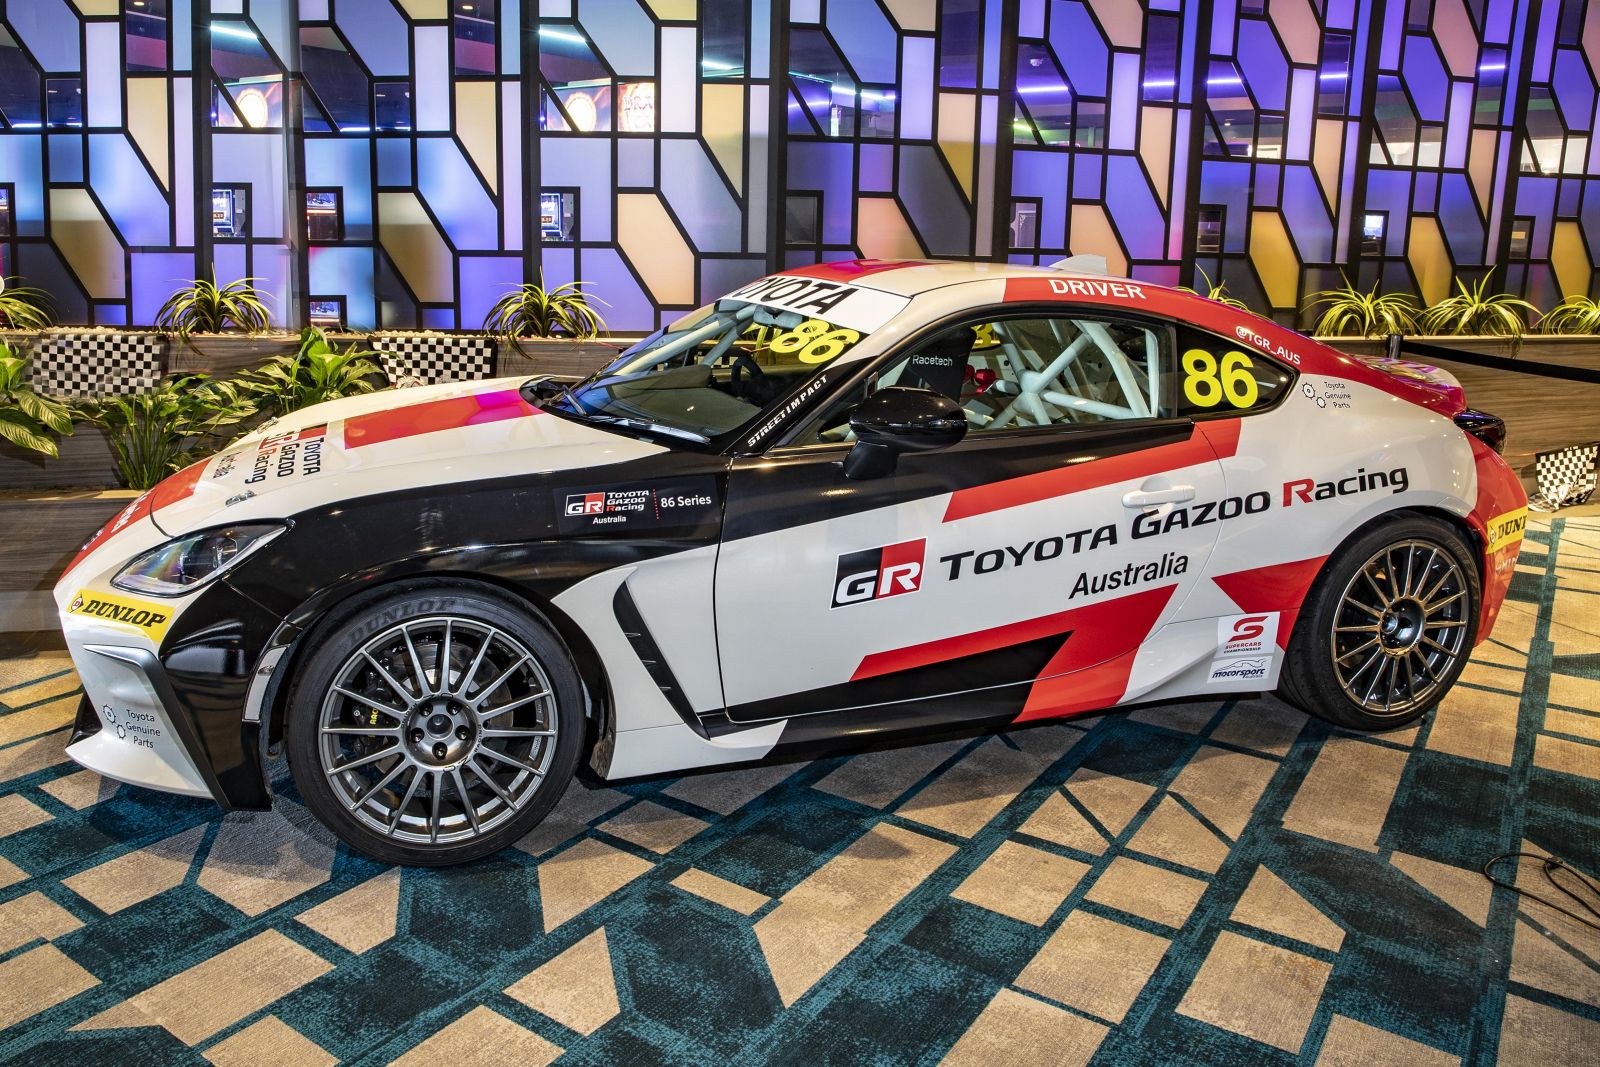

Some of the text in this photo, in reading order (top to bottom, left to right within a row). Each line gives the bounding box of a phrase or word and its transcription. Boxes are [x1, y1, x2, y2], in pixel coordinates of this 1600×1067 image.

[1048, 279, 1147, 299] DRIVER
[769, 319, 860, 364] 86
[1235, 325, 1301, 365] @TGR_AUS
[912, 354, 953, 367] Racetech
[1182, 349, 1258, 408] 86
[1324, 381, 1346, 391] Toyota
[1324, 391, 1352, 401] Genuine
[1332, 401, 1351, 409] Parts
[277, 442, 300, 478] GAZOO
[303, 437, 325, 477] TOYOTA
[607, 490, 650, 499] TOYOTA
[607, 497, 646, 505] GAZOO
[567, 501, 602, 515] GR
[606, 503, 645, 512] Racing
[660, 495, 712, 508] 86 Series
[592, 515, 627, 525] Australia
[940, 467, 1409, 581] TOYOTA GAZOO Racing
[1068, 551, 1189, 600] Australia
[835, 561, 921, 604] GR
[82, 599, 167, 627] DUNLOP
[1225, 641, 1262, 650] SUPERCARS
[1212, 668, 1266, 679] motorsport
[126, 709, 155, 722] Toyota
[126, 722, 160, 736] Genuine
[133, 736, 154, 748] Parts
